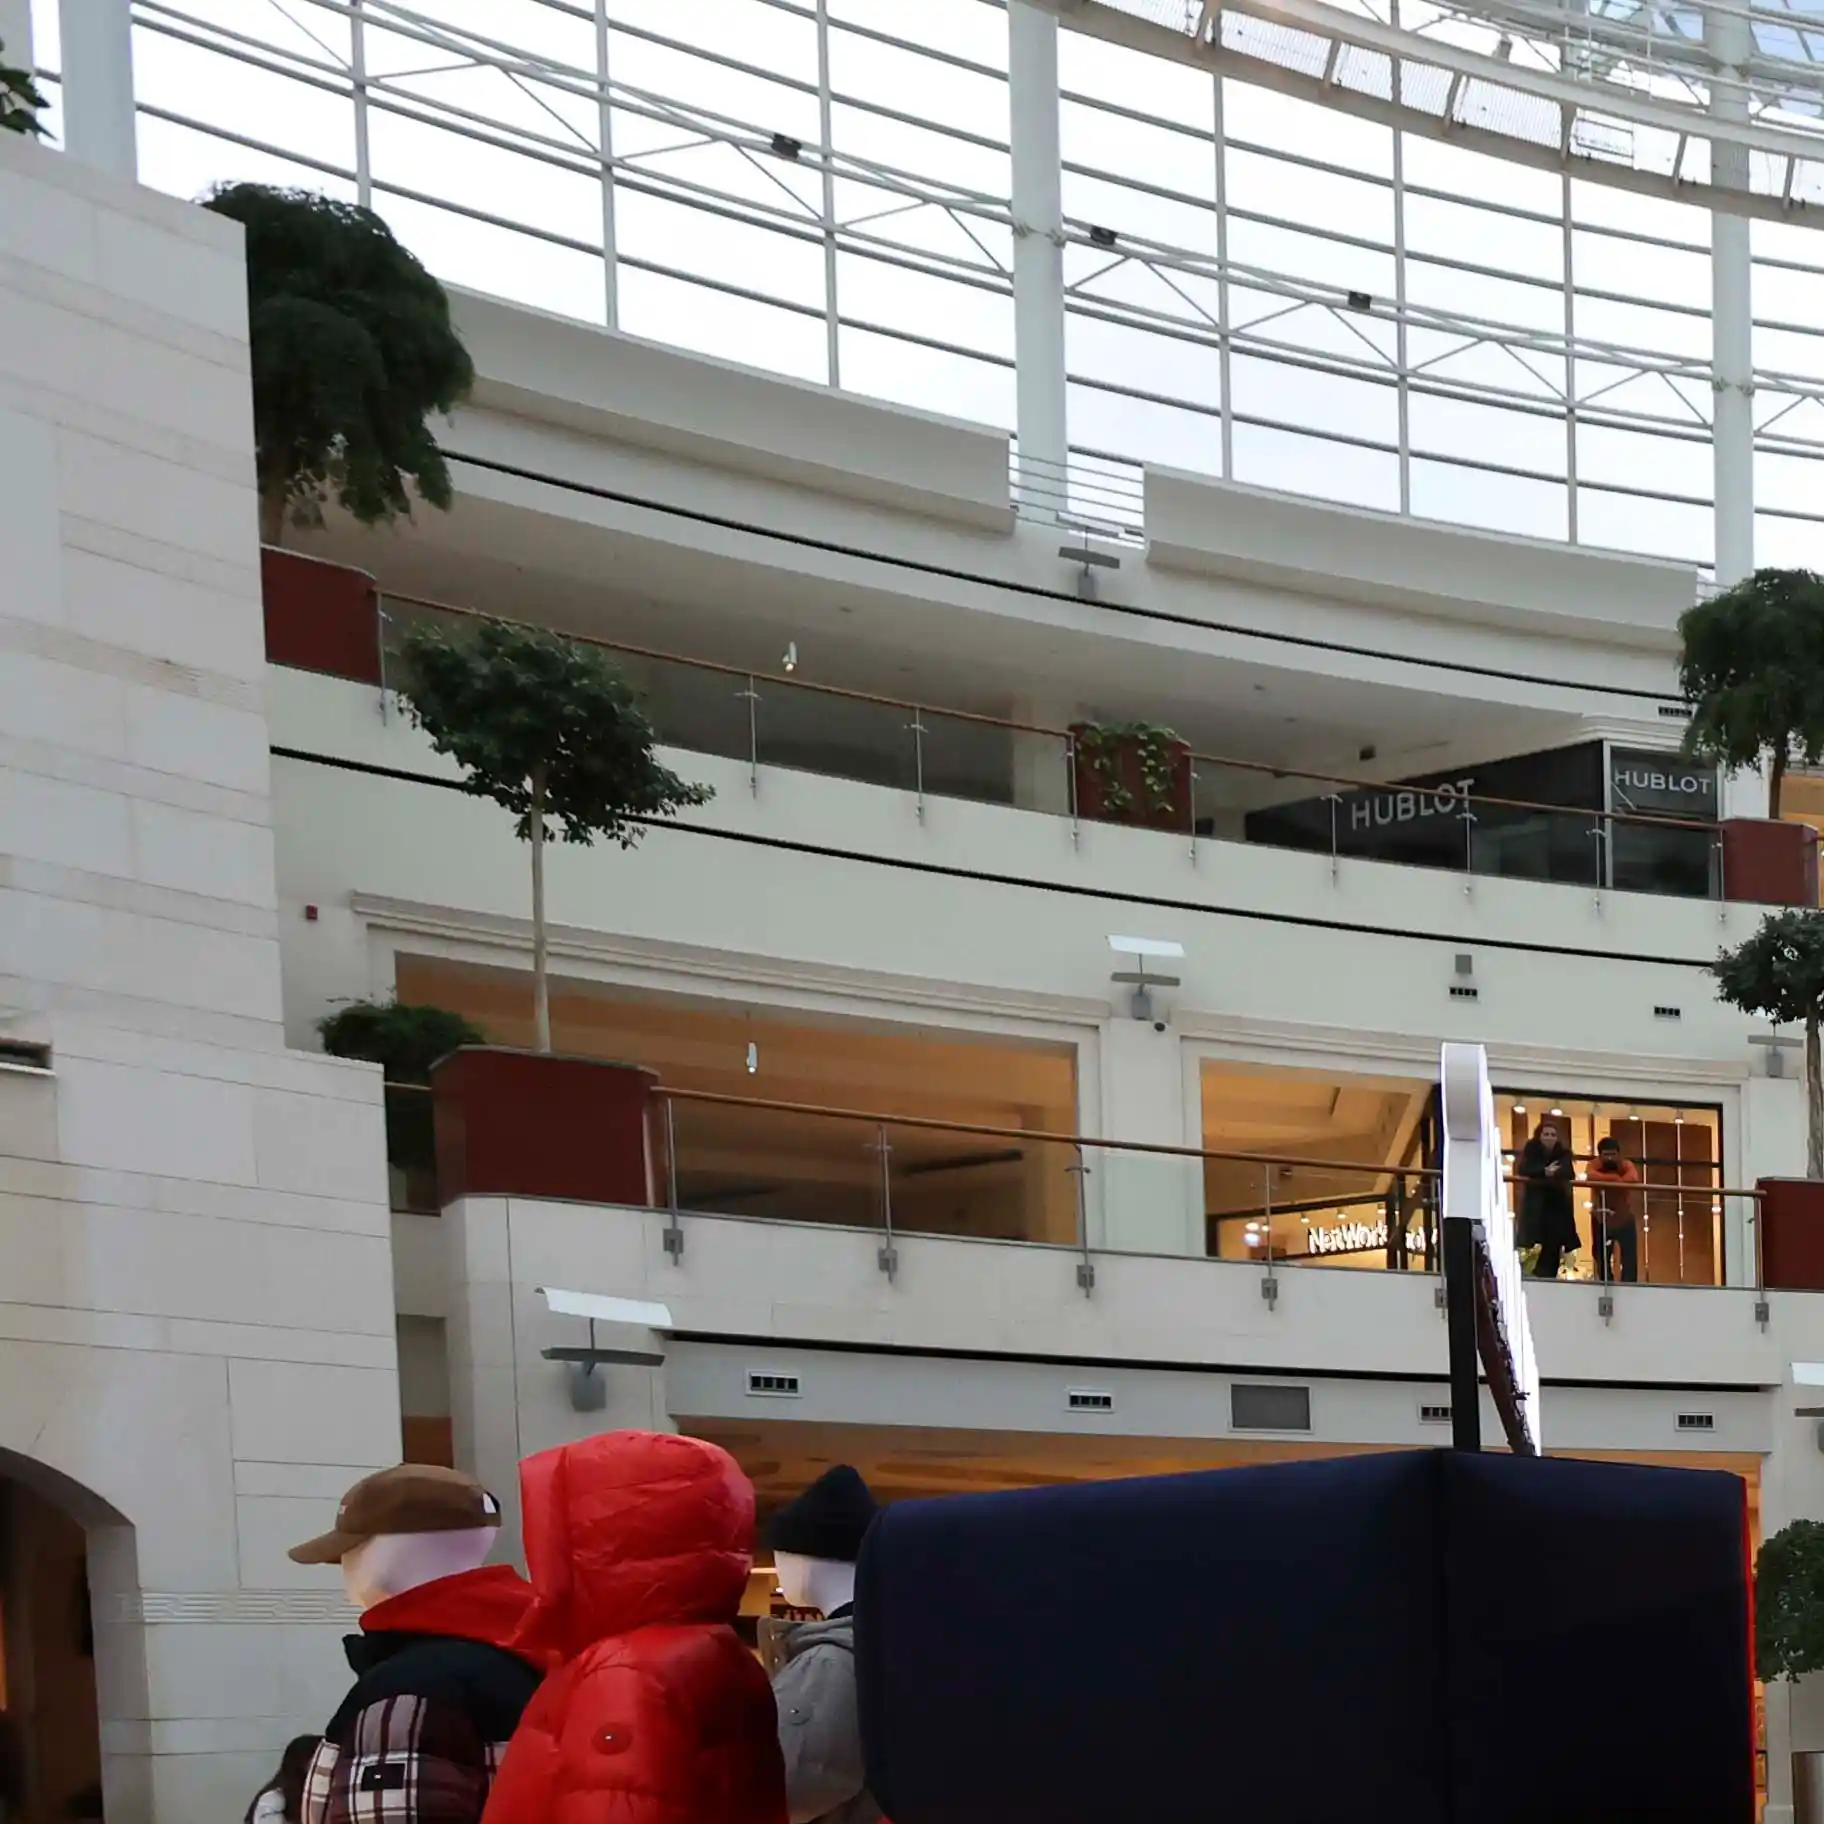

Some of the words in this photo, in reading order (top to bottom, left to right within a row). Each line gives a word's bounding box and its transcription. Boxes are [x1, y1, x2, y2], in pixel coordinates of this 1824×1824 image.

[1614, 767, 1713, 796] HUBLOT
[1351, 778, 1475, 832] HUBLOT
[1308, 1221, 1388, 1253] NetWork
